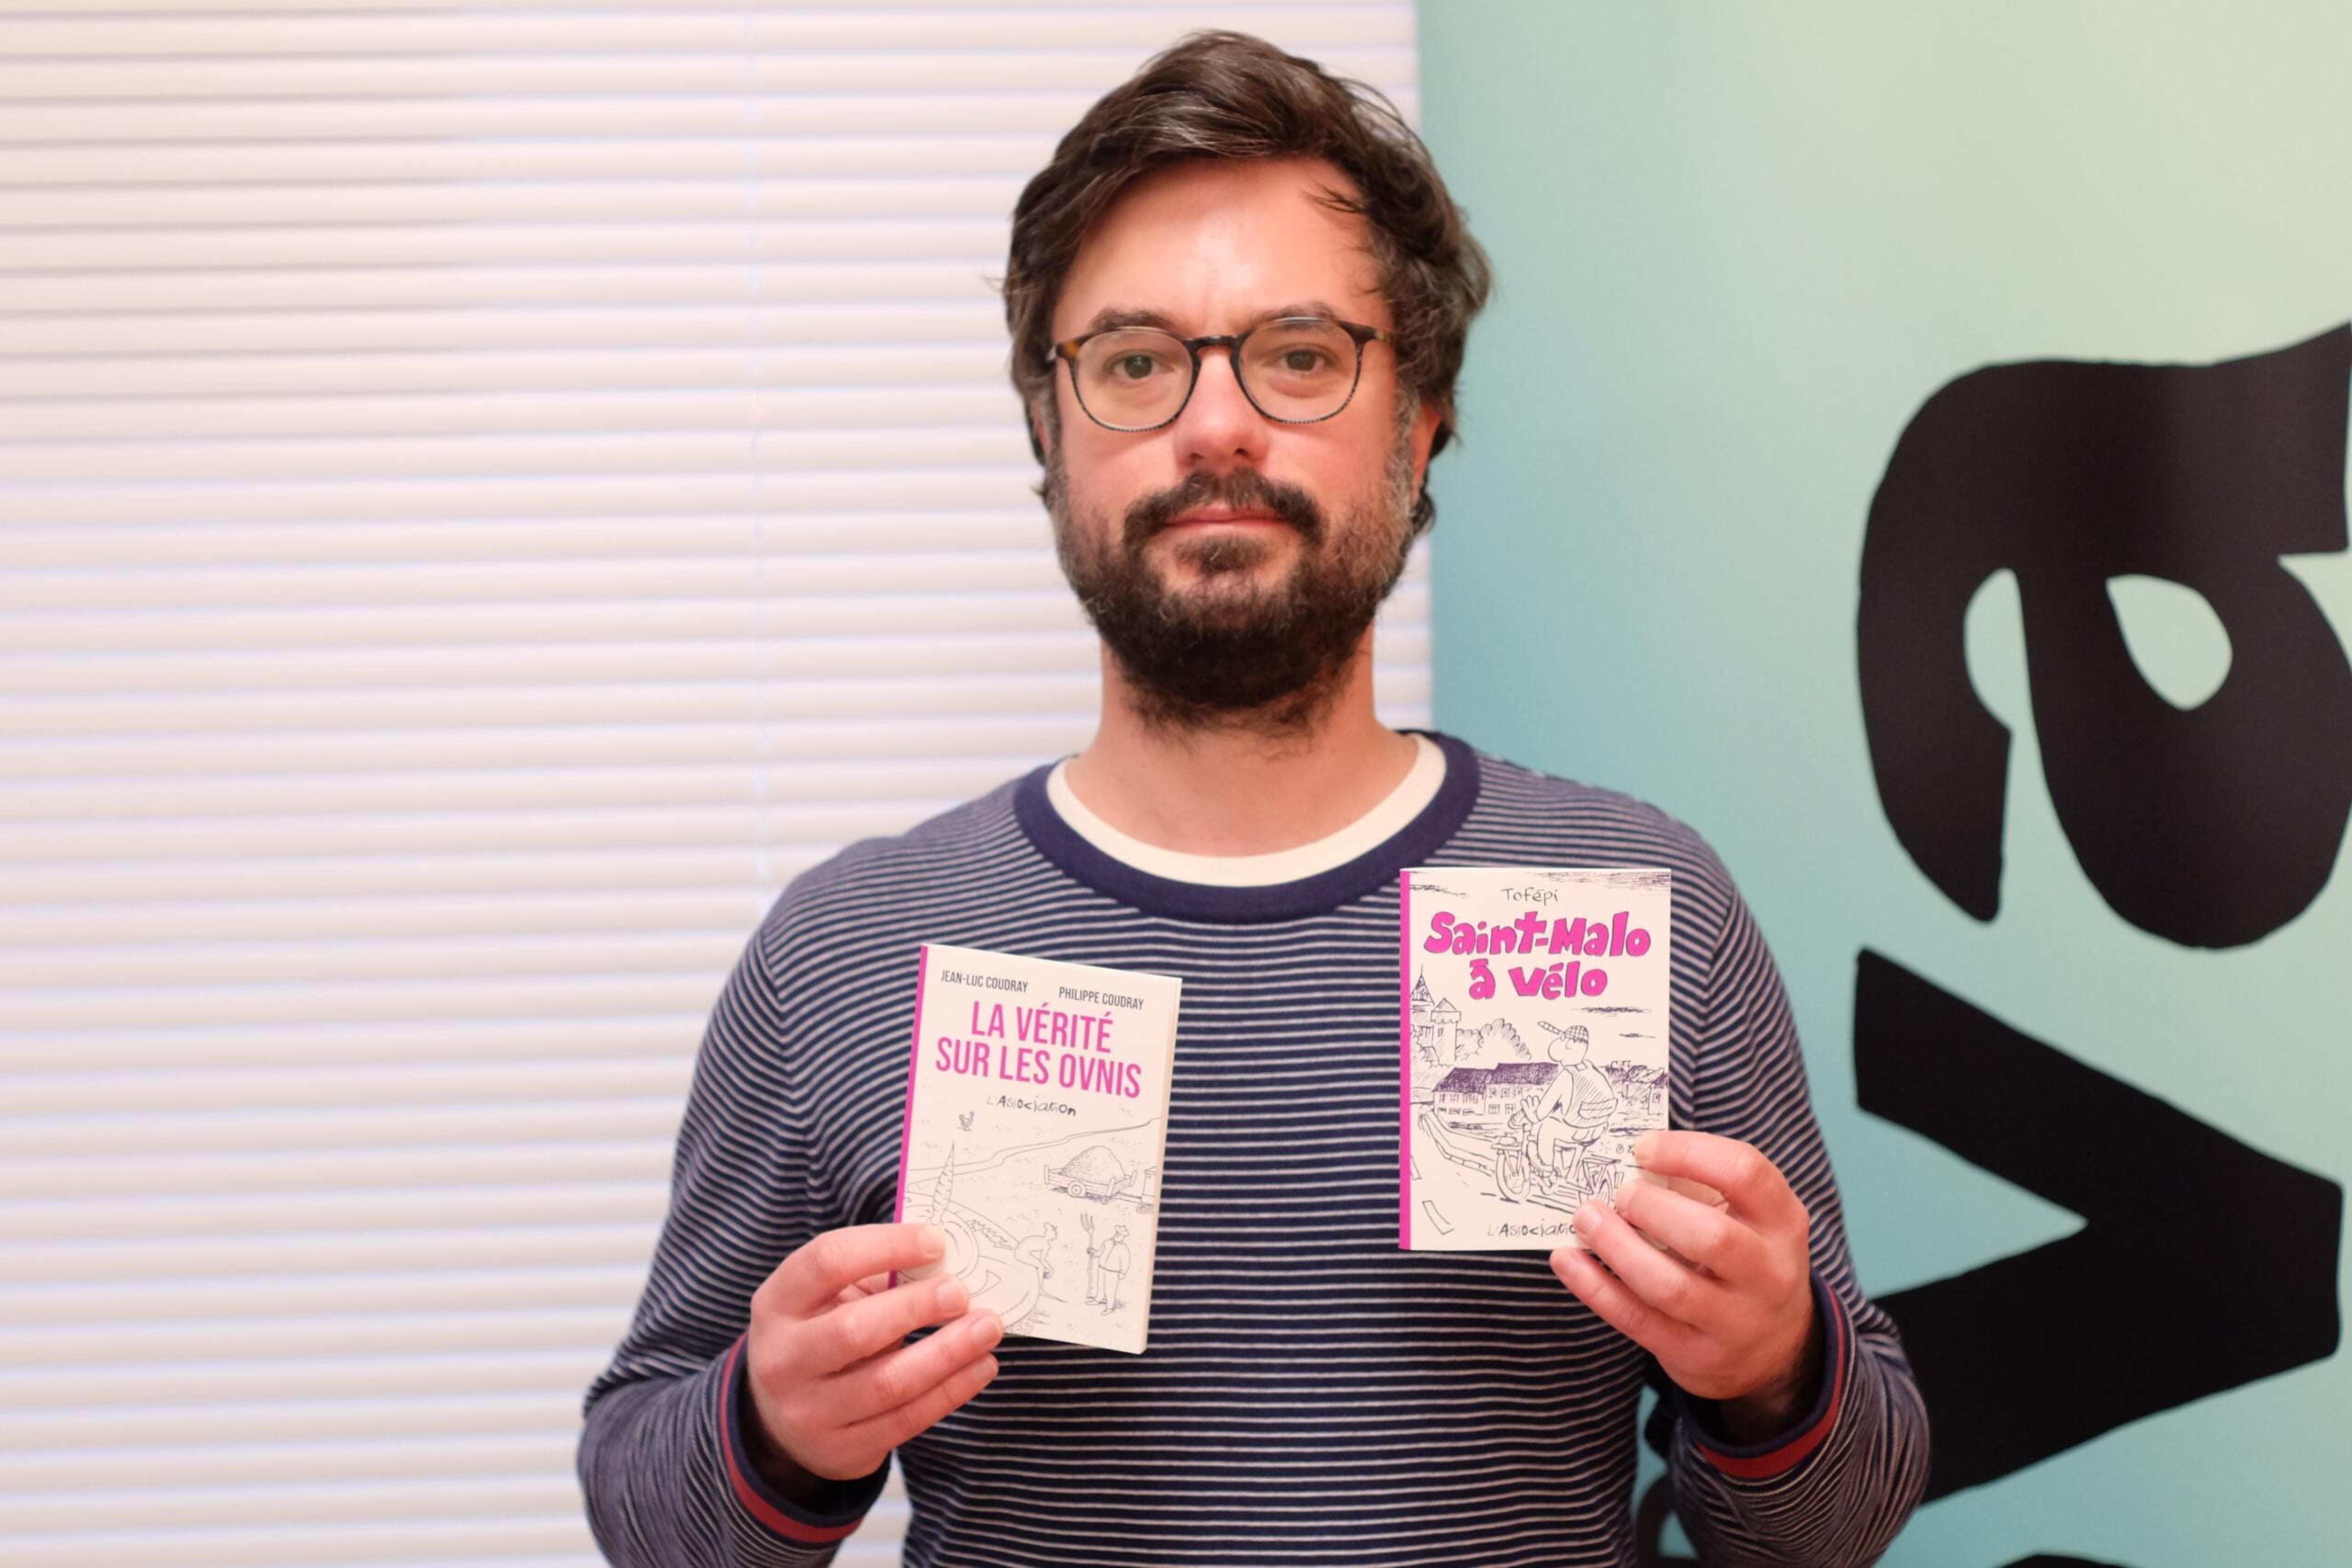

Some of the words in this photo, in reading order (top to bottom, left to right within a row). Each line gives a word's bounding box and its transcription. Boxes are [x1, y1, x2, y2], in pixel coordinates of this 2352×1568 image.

[1501, 887, 1558, 906] Tofépi
[1424, 911, 1651, 957] Saint-Malo
[1856, 317, 2352, 1568] va
[940, 970, 984, 987] JEAN-LUC
[985, 977, 1029, 993] COUDRAY
[1059, 986, 1100, 1004] PHILIPPE
[1102, 993, 1145, 1010] COUDRAY
[1469, 958, 1496, 1000] à
[972, 1001, 1005, 1038] LA
[1017, 1002, 1114, 1053] VÉRITÉ
[936, 1037, 990, 1077] SUR
[999, 1045, 1051, 1085] LES
[1059, 1053, 1142, 1099] OVNIS
